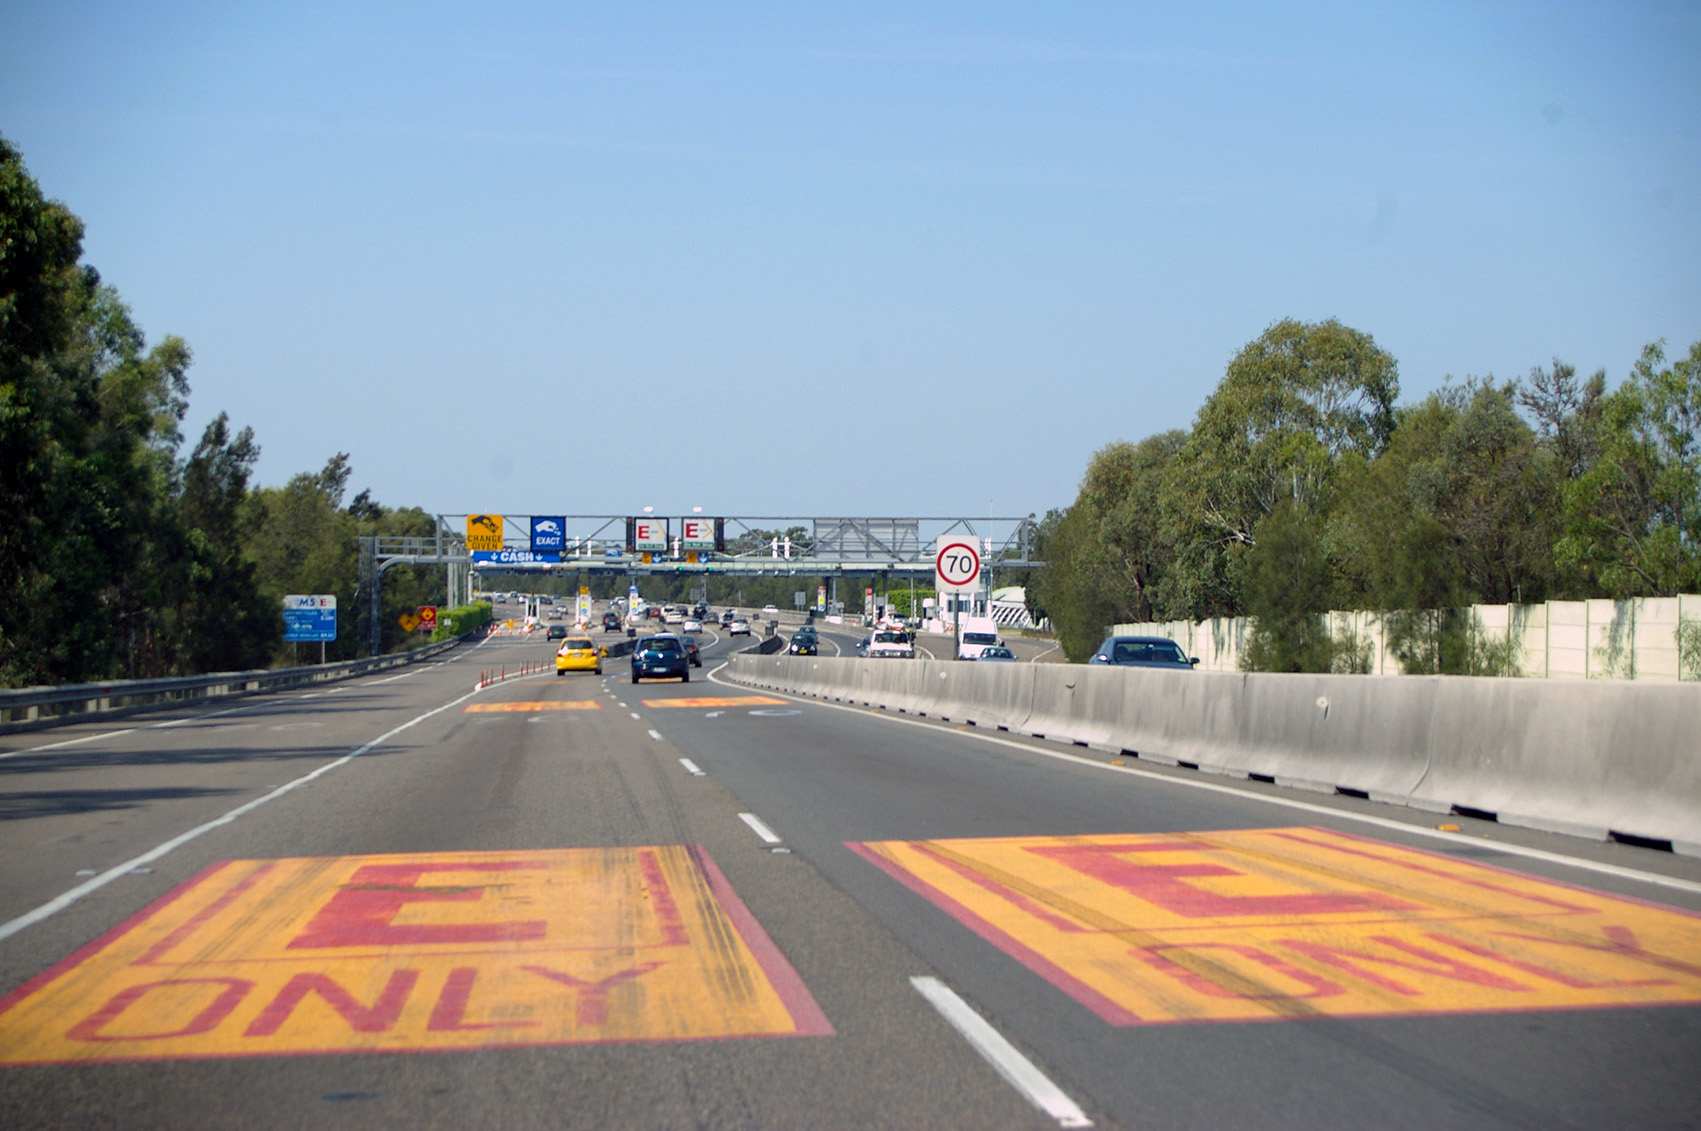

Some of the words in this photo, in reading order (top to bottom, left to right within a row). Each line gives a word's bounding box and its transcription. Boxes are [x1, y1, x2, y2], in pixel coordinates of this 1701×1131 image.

[638, 525, 650, 539] E
[685, 523, 699, 538] E
[467, 534, 502, 542] CHANGE
[535, 536, 560, 545] EXACT
[471, 542, 498, 550] GIVEN
[500, 552, 534, 562] CASH
[946, 555, 972, 574] 70
[298, 598, 316, 607] M5
[1024, 840, 1433, 918] E
[285, 860, 555, 949] E
[65, 959, 665, 1042] ONLY
